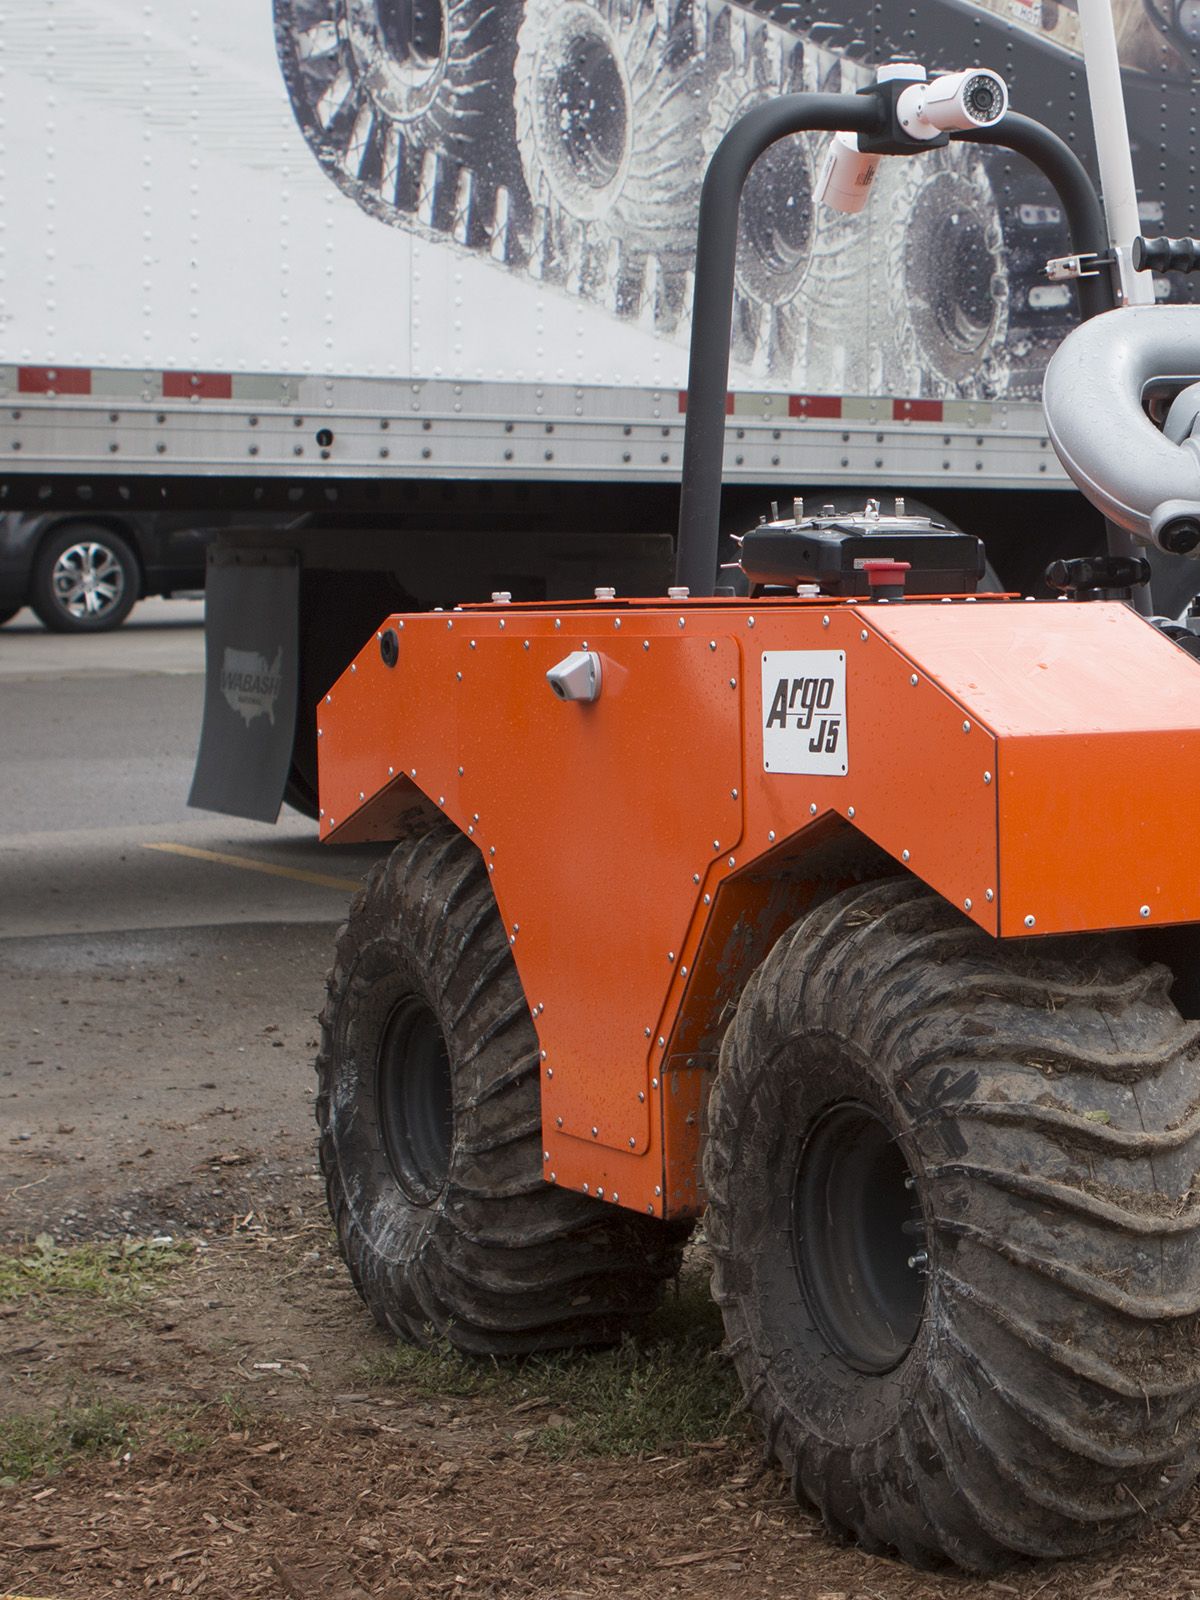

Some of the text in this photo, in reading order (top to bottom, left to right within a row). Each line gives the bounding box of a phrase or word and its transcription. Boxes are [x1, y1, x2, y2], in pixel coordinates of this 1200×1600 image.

[221, 672, 281, 696] WABASH
[766, 677, 834, 729] Argo
[809, 719, 840, 753] J5
